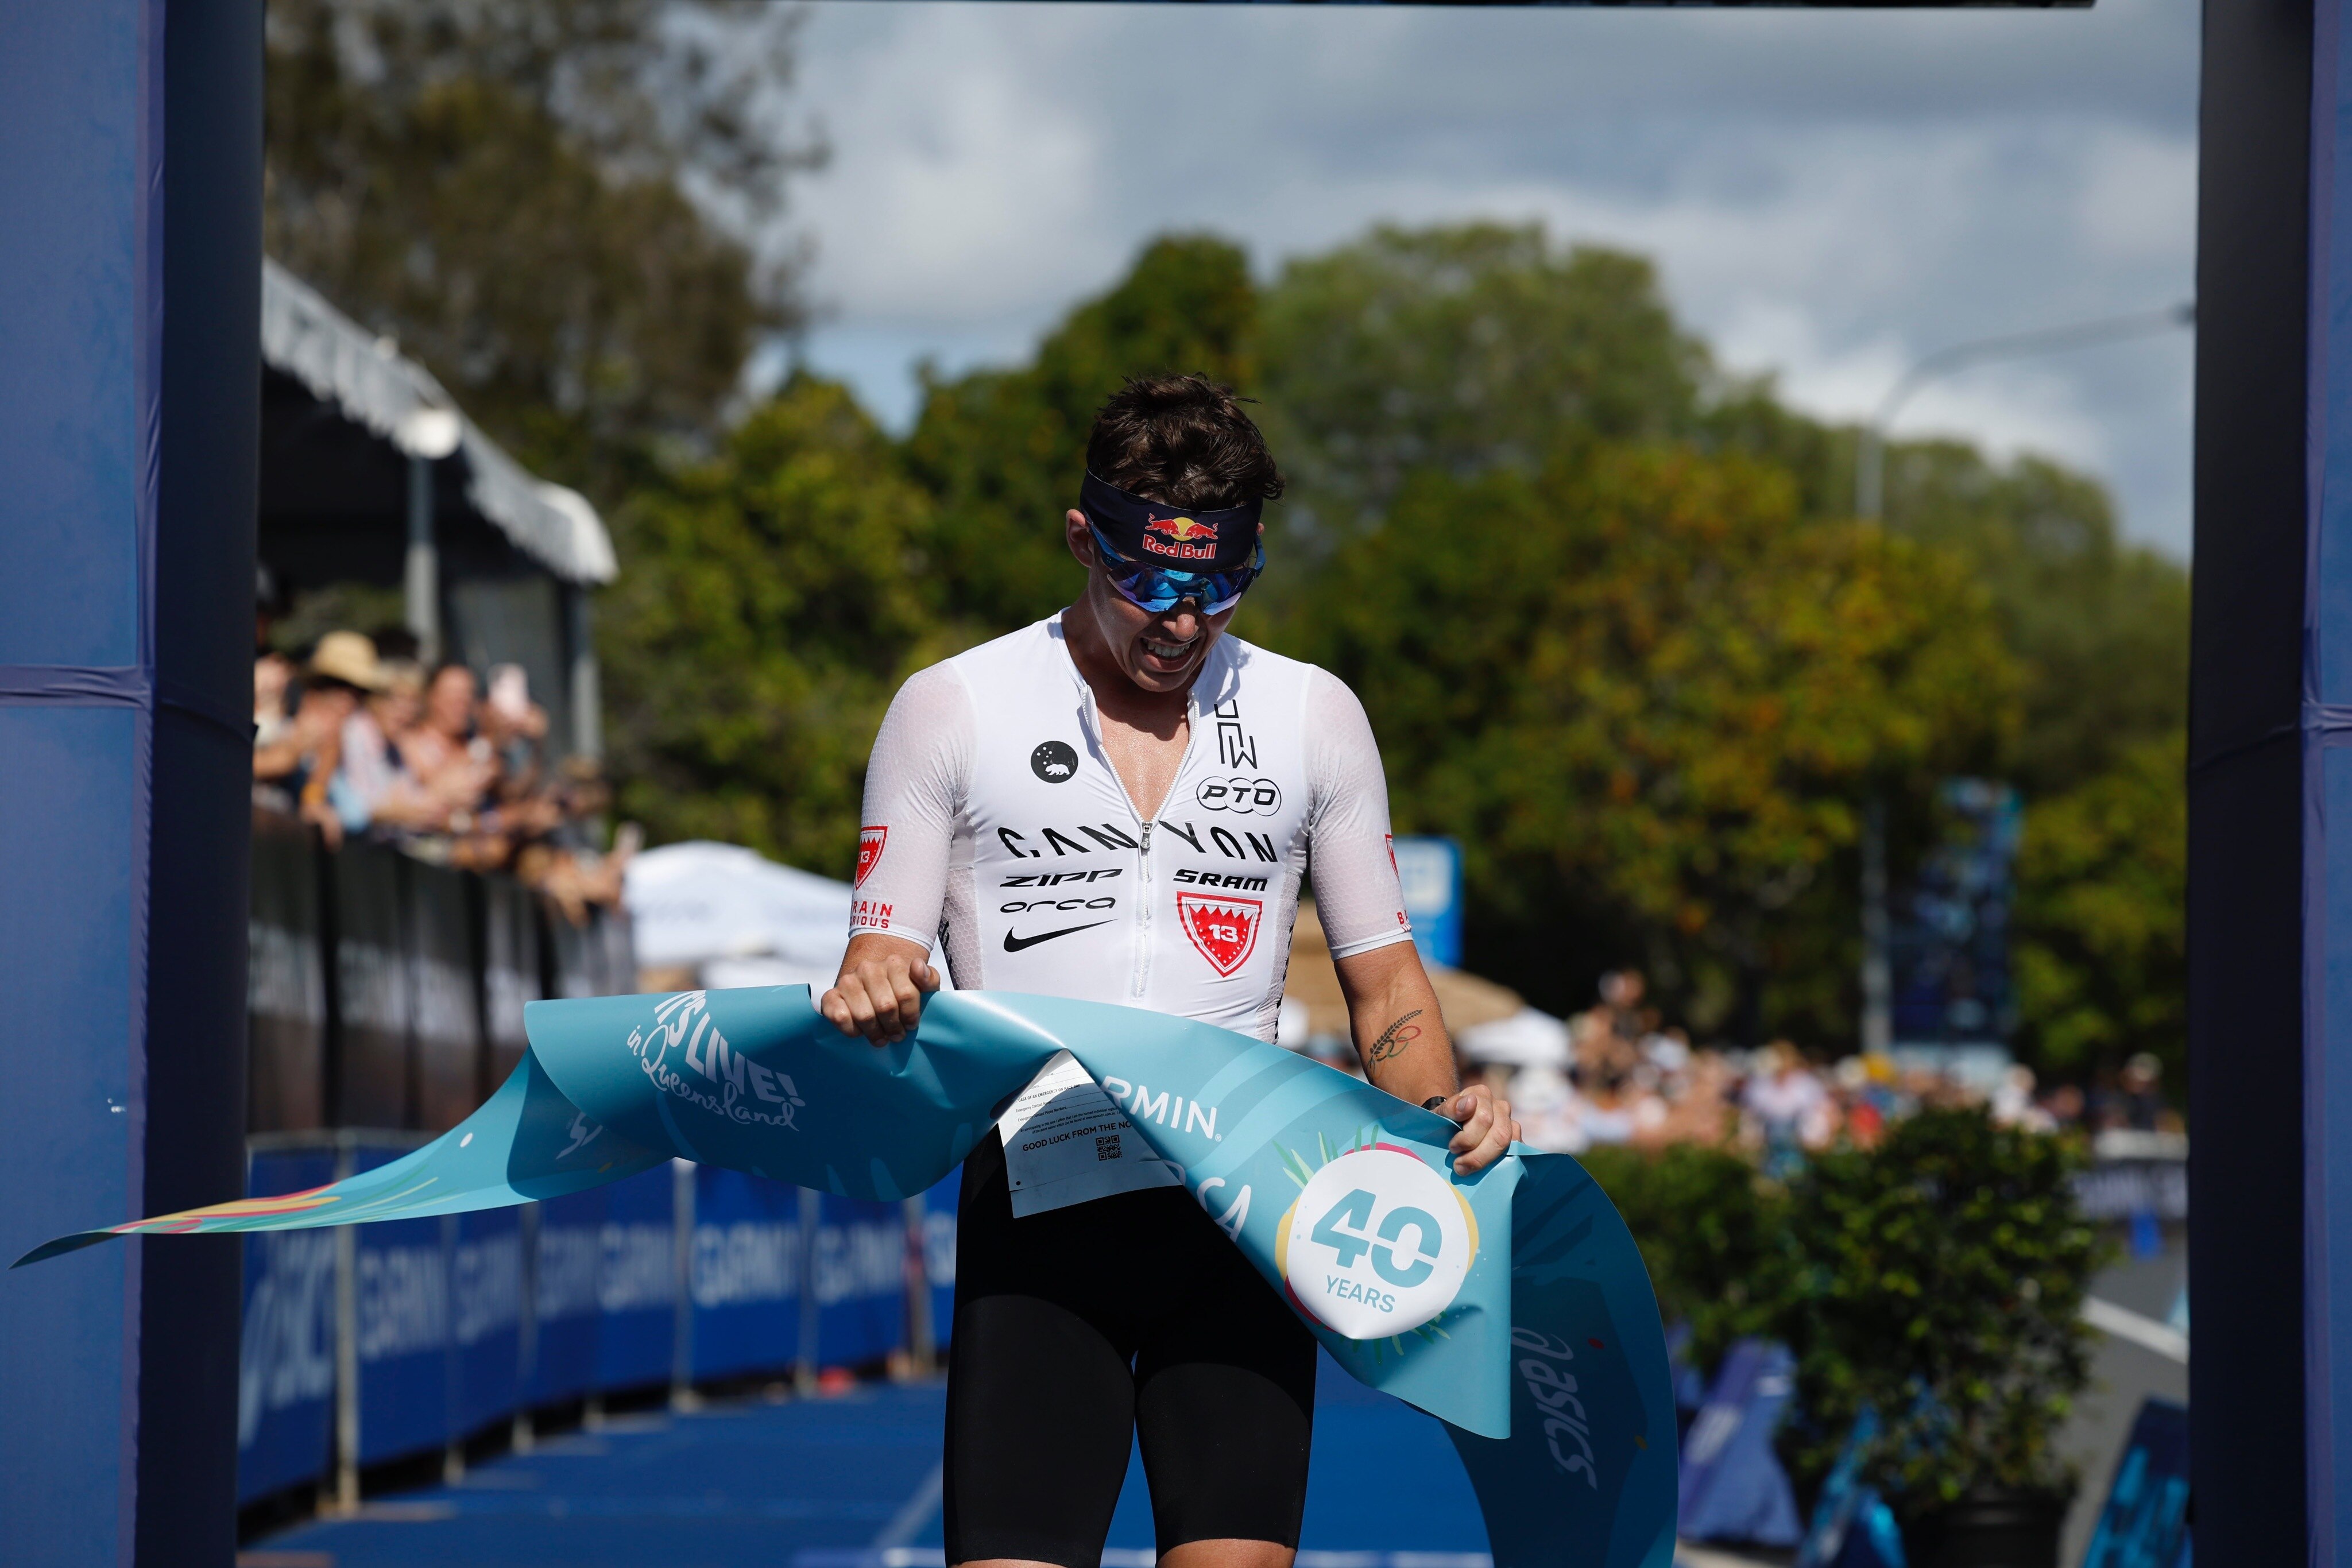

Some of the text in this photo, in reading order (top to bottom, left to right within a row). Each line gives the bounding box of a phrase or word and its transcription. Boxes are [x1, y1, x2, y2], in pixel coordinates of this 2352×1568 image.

[1142, 534, 1217, 559] Red Bull
[1201, 784, 1276, 806] PTO
[860, 850, 870, 864] 13
[1000, 869, 1123, 888] ZIPP
[1173, 869, 1268, 891] SRAM
[852, 901, 893, 917] RAIN
[1000, 897, 1116, 913] orca
[850, 916, 890, 929] RIOUS
[1208, 923, 1239, 943] 13
[685, 1012, 806, 1107] LIVE!
[626, 1024, 800, 1132] in Queensland
[1023, 1139, 1047, 1151] GOOD
[1049, 1132, 1071, 1145] LUCK
[1071, 1126, 1097, 1139] FROM
[1098, 1122, 1117, 1132] THE
[1310, 1188, 1442, 1288] 40
[1326, 1274, 1396, 1313] YEARS
[1518, 1358, 1598, 1492] asics
